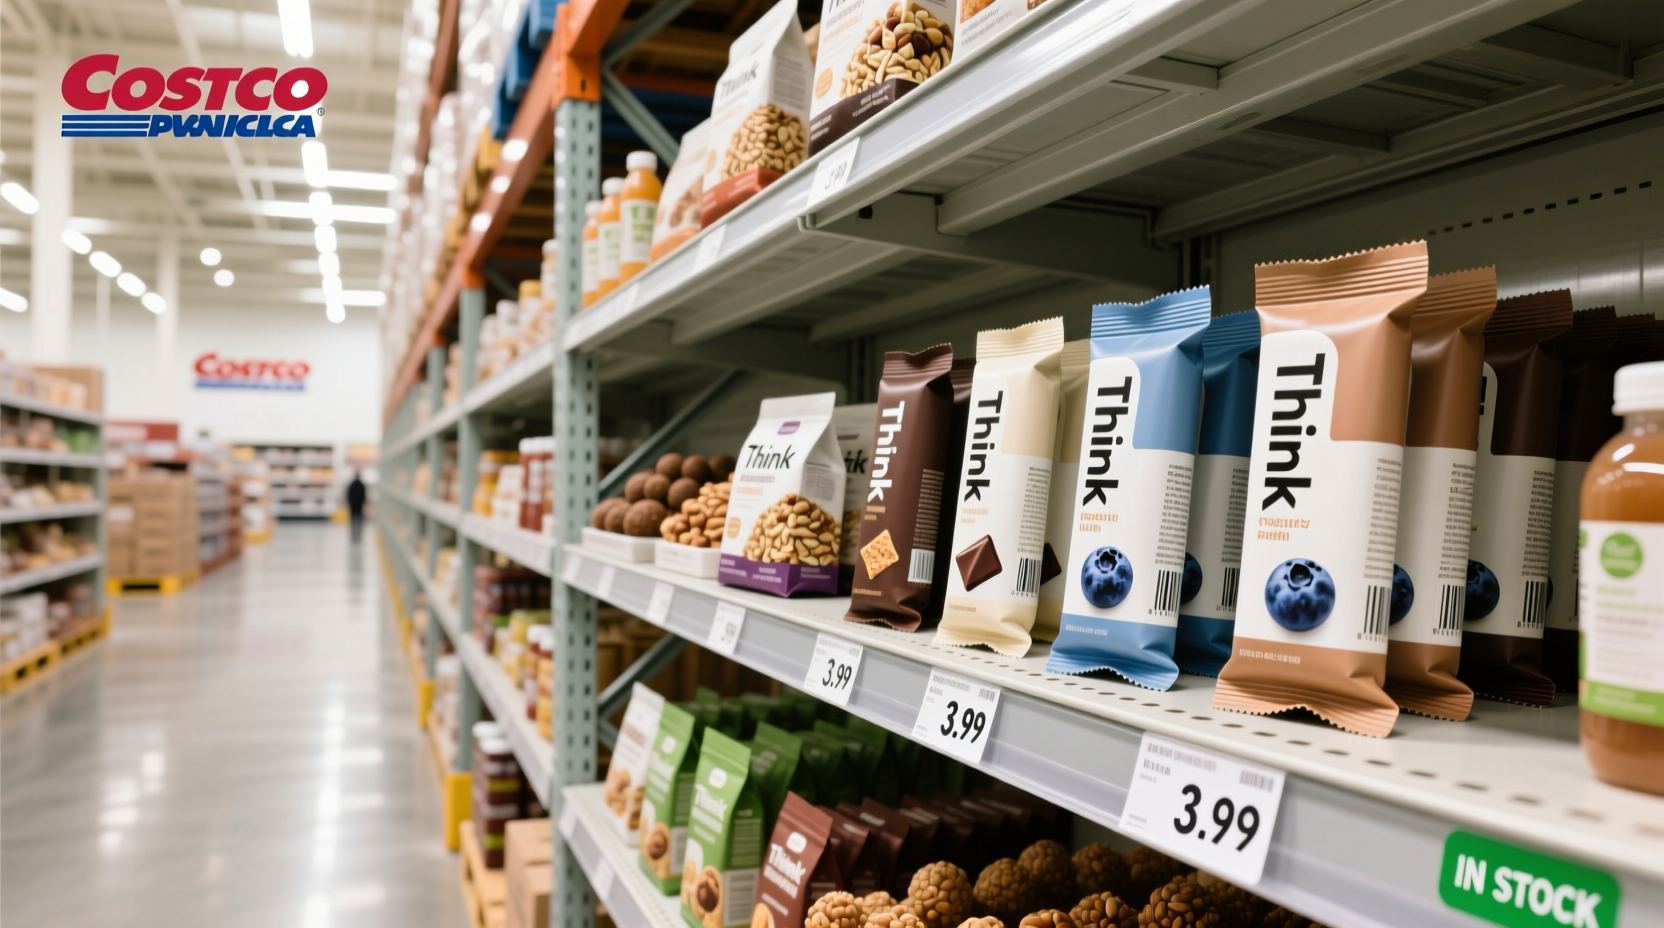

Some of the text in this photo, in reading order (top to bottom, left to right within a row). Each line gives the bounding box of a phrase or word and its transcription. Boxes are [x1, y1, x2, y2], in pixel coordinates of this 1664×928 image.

[745, 444, 796, 470] Think
[867, 400, 905, 503] Think
[963, 390, 1003, 502] Think
[1082, 376, 1133, 506] Think
[1261, 353, 1326, 511] Think
[822, 658, 852, 690] 3.99
[940, 700, 986, 744] 3.99
[1173, 783, 1260, 852] 3.99
[1453, 853, 1602, 928] IN STOCK
